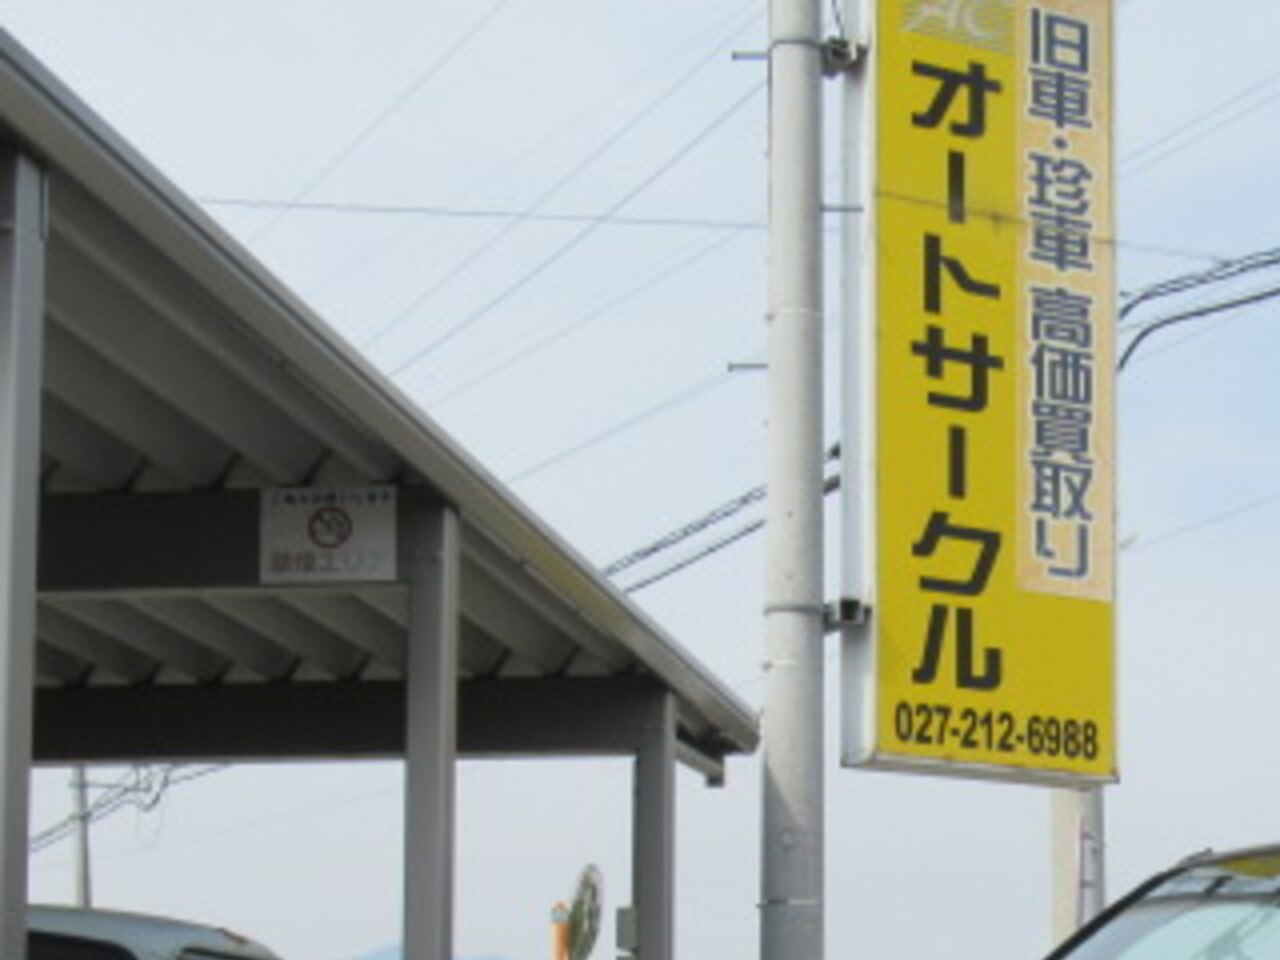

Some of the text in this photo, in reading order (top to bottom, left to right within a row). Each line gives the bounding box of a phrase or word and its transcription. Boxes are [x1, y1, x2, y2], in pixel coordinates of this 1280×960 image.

[911, 60, 1004, 692] オートサークル
[1028, 8, 1092, 577] 旧車・珍車 高価買取り
[895, 702, 1098, 760] 027-212-6988
